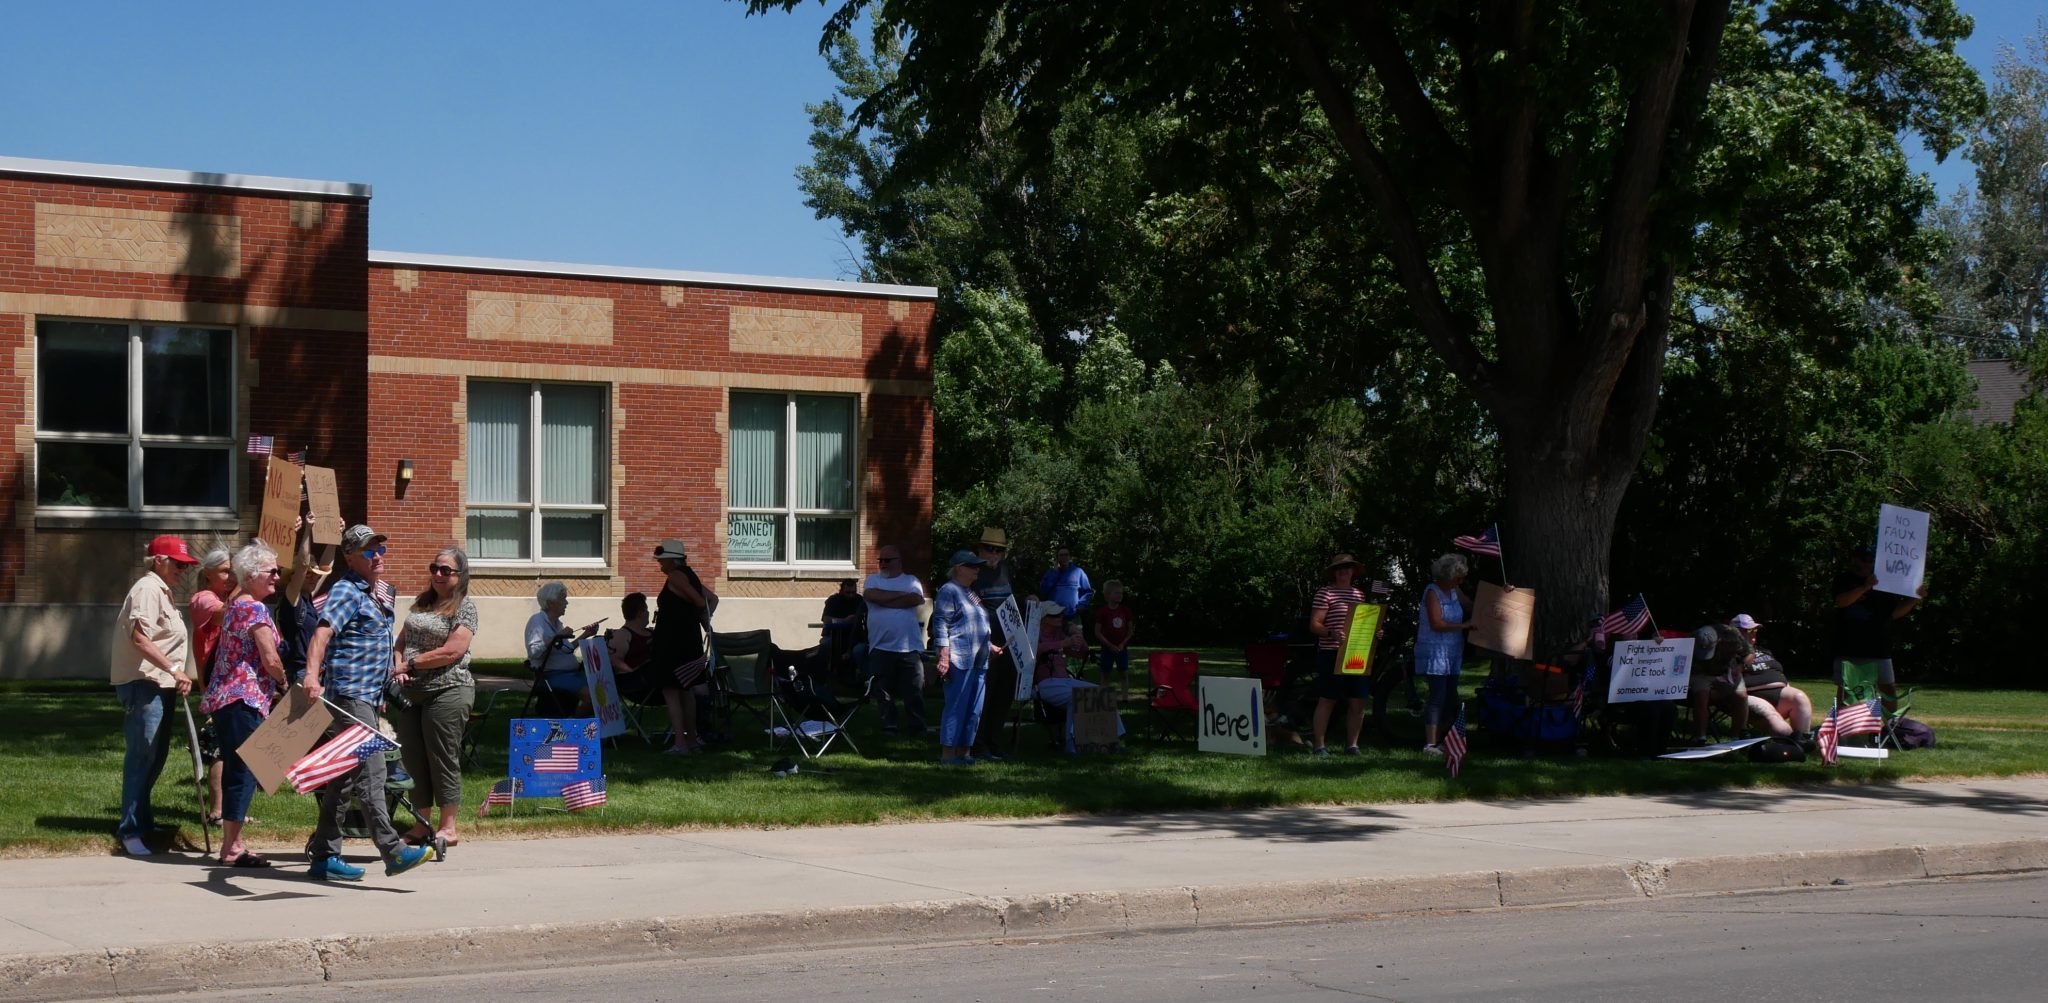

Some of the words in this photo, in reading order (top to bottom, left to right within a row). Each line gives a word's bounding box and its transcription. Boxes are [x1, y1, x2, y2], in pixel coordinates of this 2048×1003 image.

[267, 467, 282, 499] NO
[1896, 515, 1911, 527] NO
[260, 516, 295, 548] KINGS
[728, 522, 774, 537] CONNECT
[1884, 526, 1916, 541] FAUX
[1884, 542, 1920, 560] KING
[1886, 559, 1912, 577] WAY
[1626, 644, 1646, 656] Fight
[1619, 655, 1634, 665] Not
[1631, 667, 1647, 677] ICE
[1649, 667, 1666, 677] took
[1616, 686, 1649, 695] someone
[1202, 686, 1259, 749] here!
